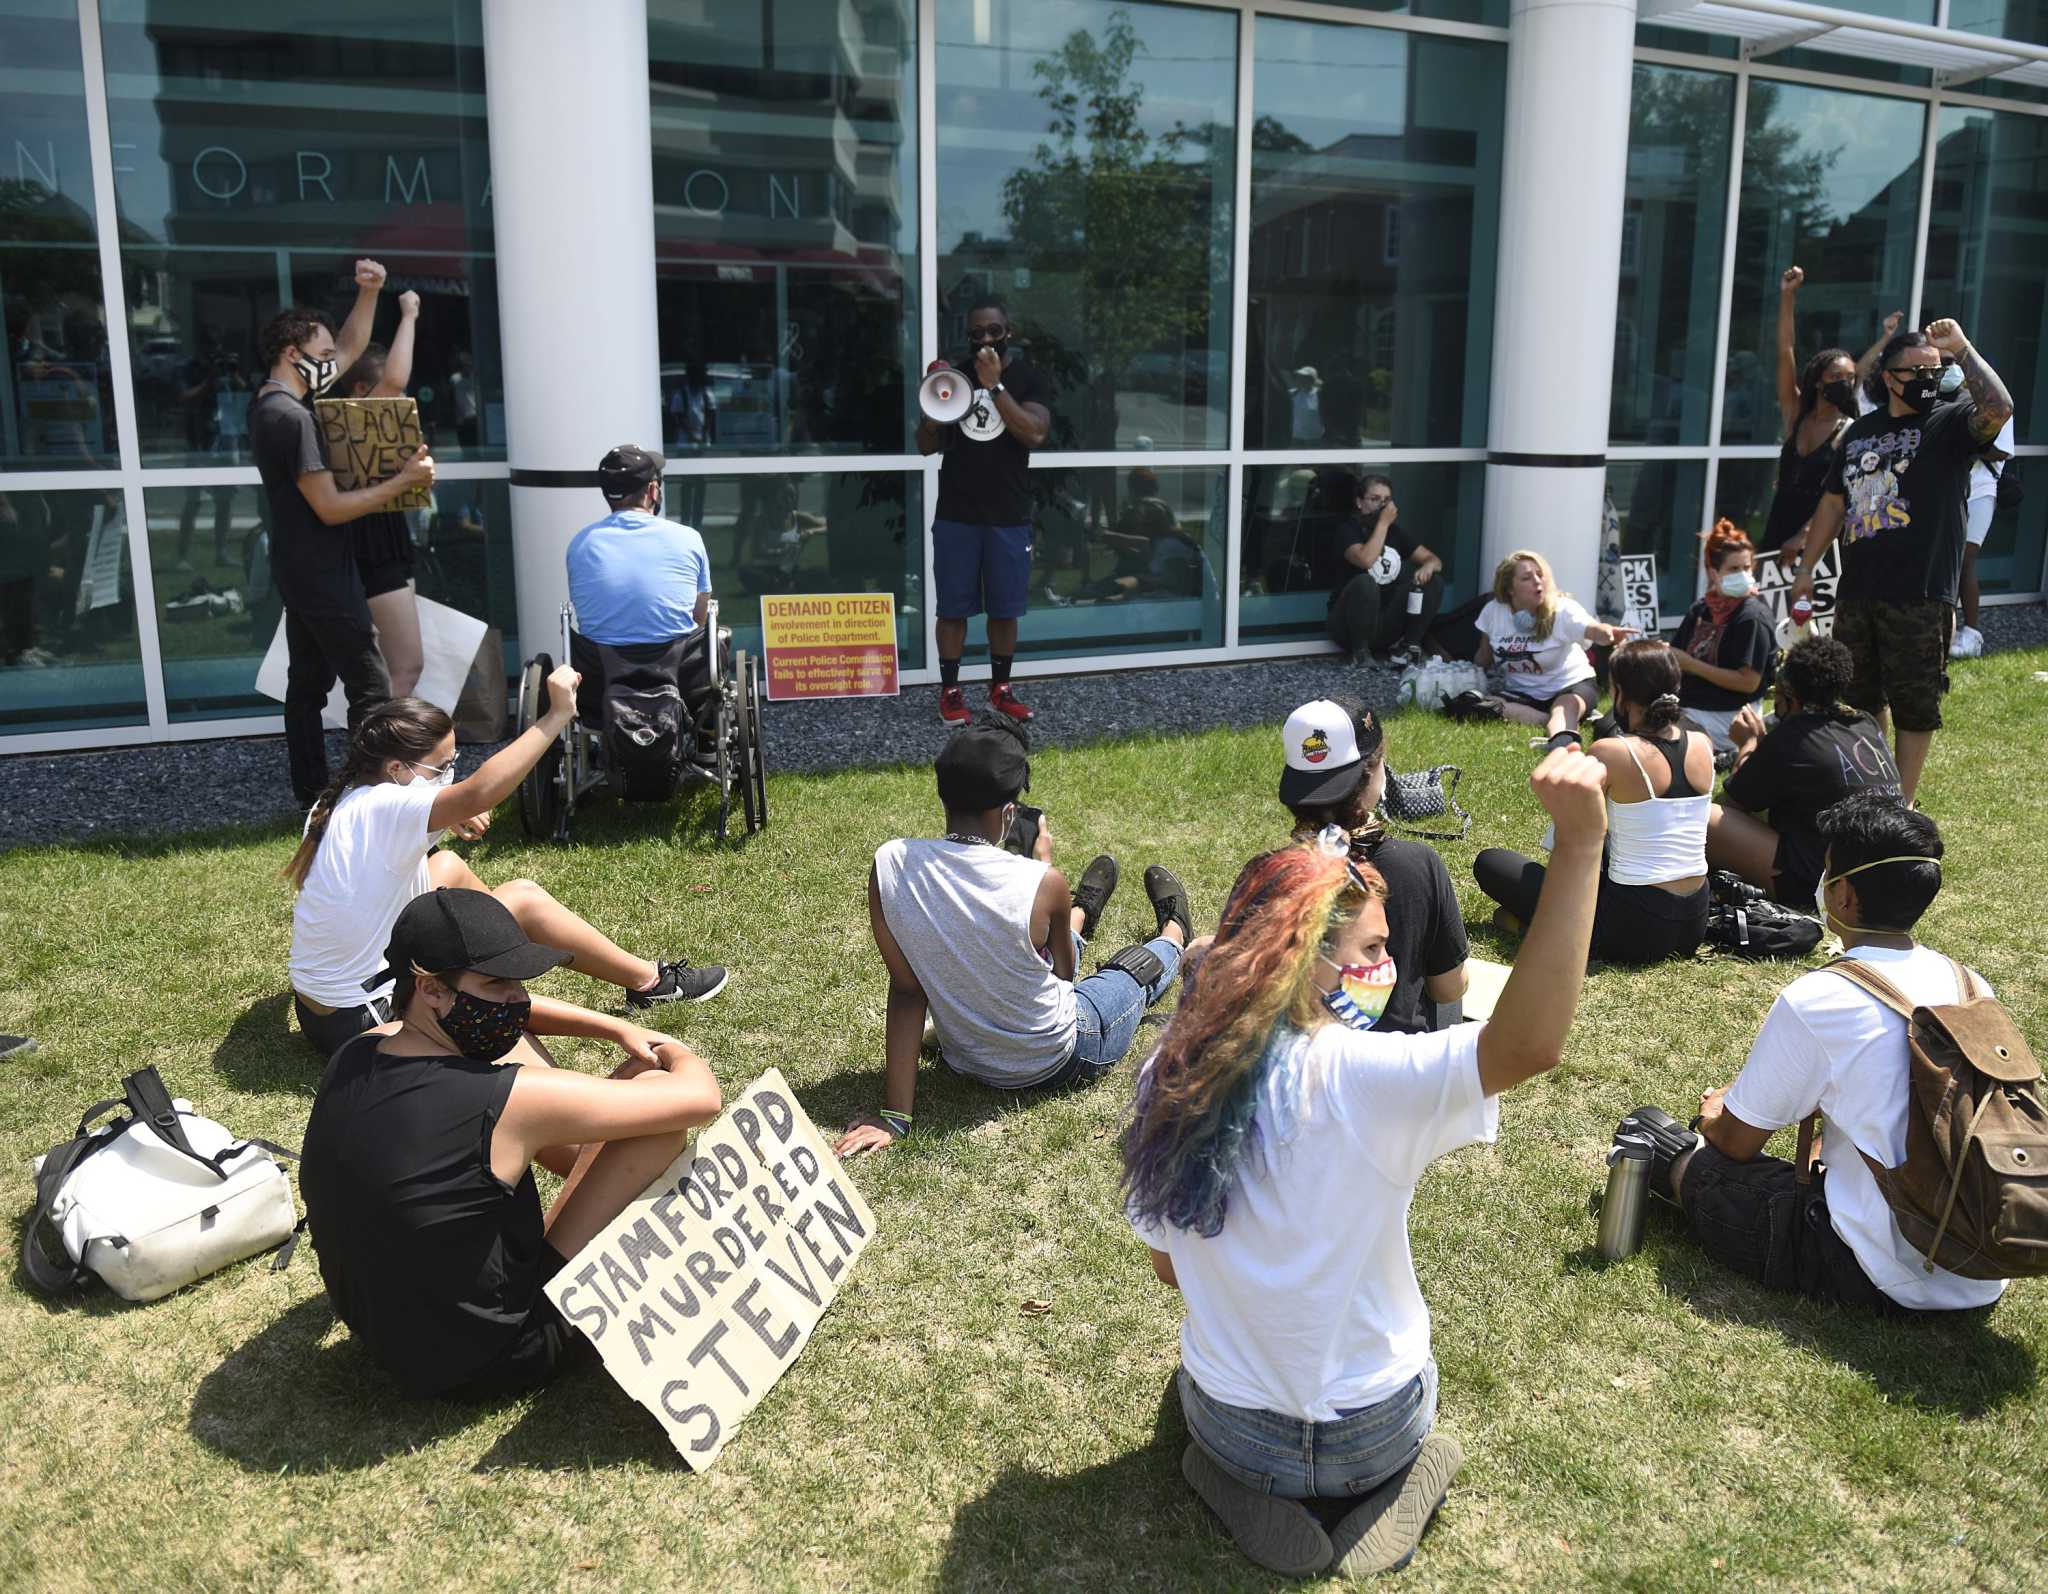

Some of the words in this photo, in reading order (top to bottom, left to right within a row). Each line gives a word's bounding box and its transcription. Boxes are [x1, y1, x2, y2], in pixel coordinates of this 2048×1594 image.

[320, 401, 420, 444] BLACK
[328, 443, 418, 476] LIVES
[768, 601, 832, 617] DEMAND
[836, 600, 890, 615] CITIZEN
[770, 619, 830, 630] involvement
[833, 619, 842, 629] in
[844, 618, 886, 629] direction
[777, 633, 788, 643] of
[791, 633, 820, 643] Police
[823, 632, 881, 643] Department.
[772, 656, 808, 667] Current
[810, 655, 837, 665] Police
[796, 669, 806, 679] to
[808, 667, 854, 679] effectively
[883, 667, 892, 676] in
[559, 1142, 748, 1342] STAMFORD
[732, 1090, 794, 1163] PD
[626, 1146, 819, 1366] MURDERED
[660, 1178, 867, 1453] STEVEN
